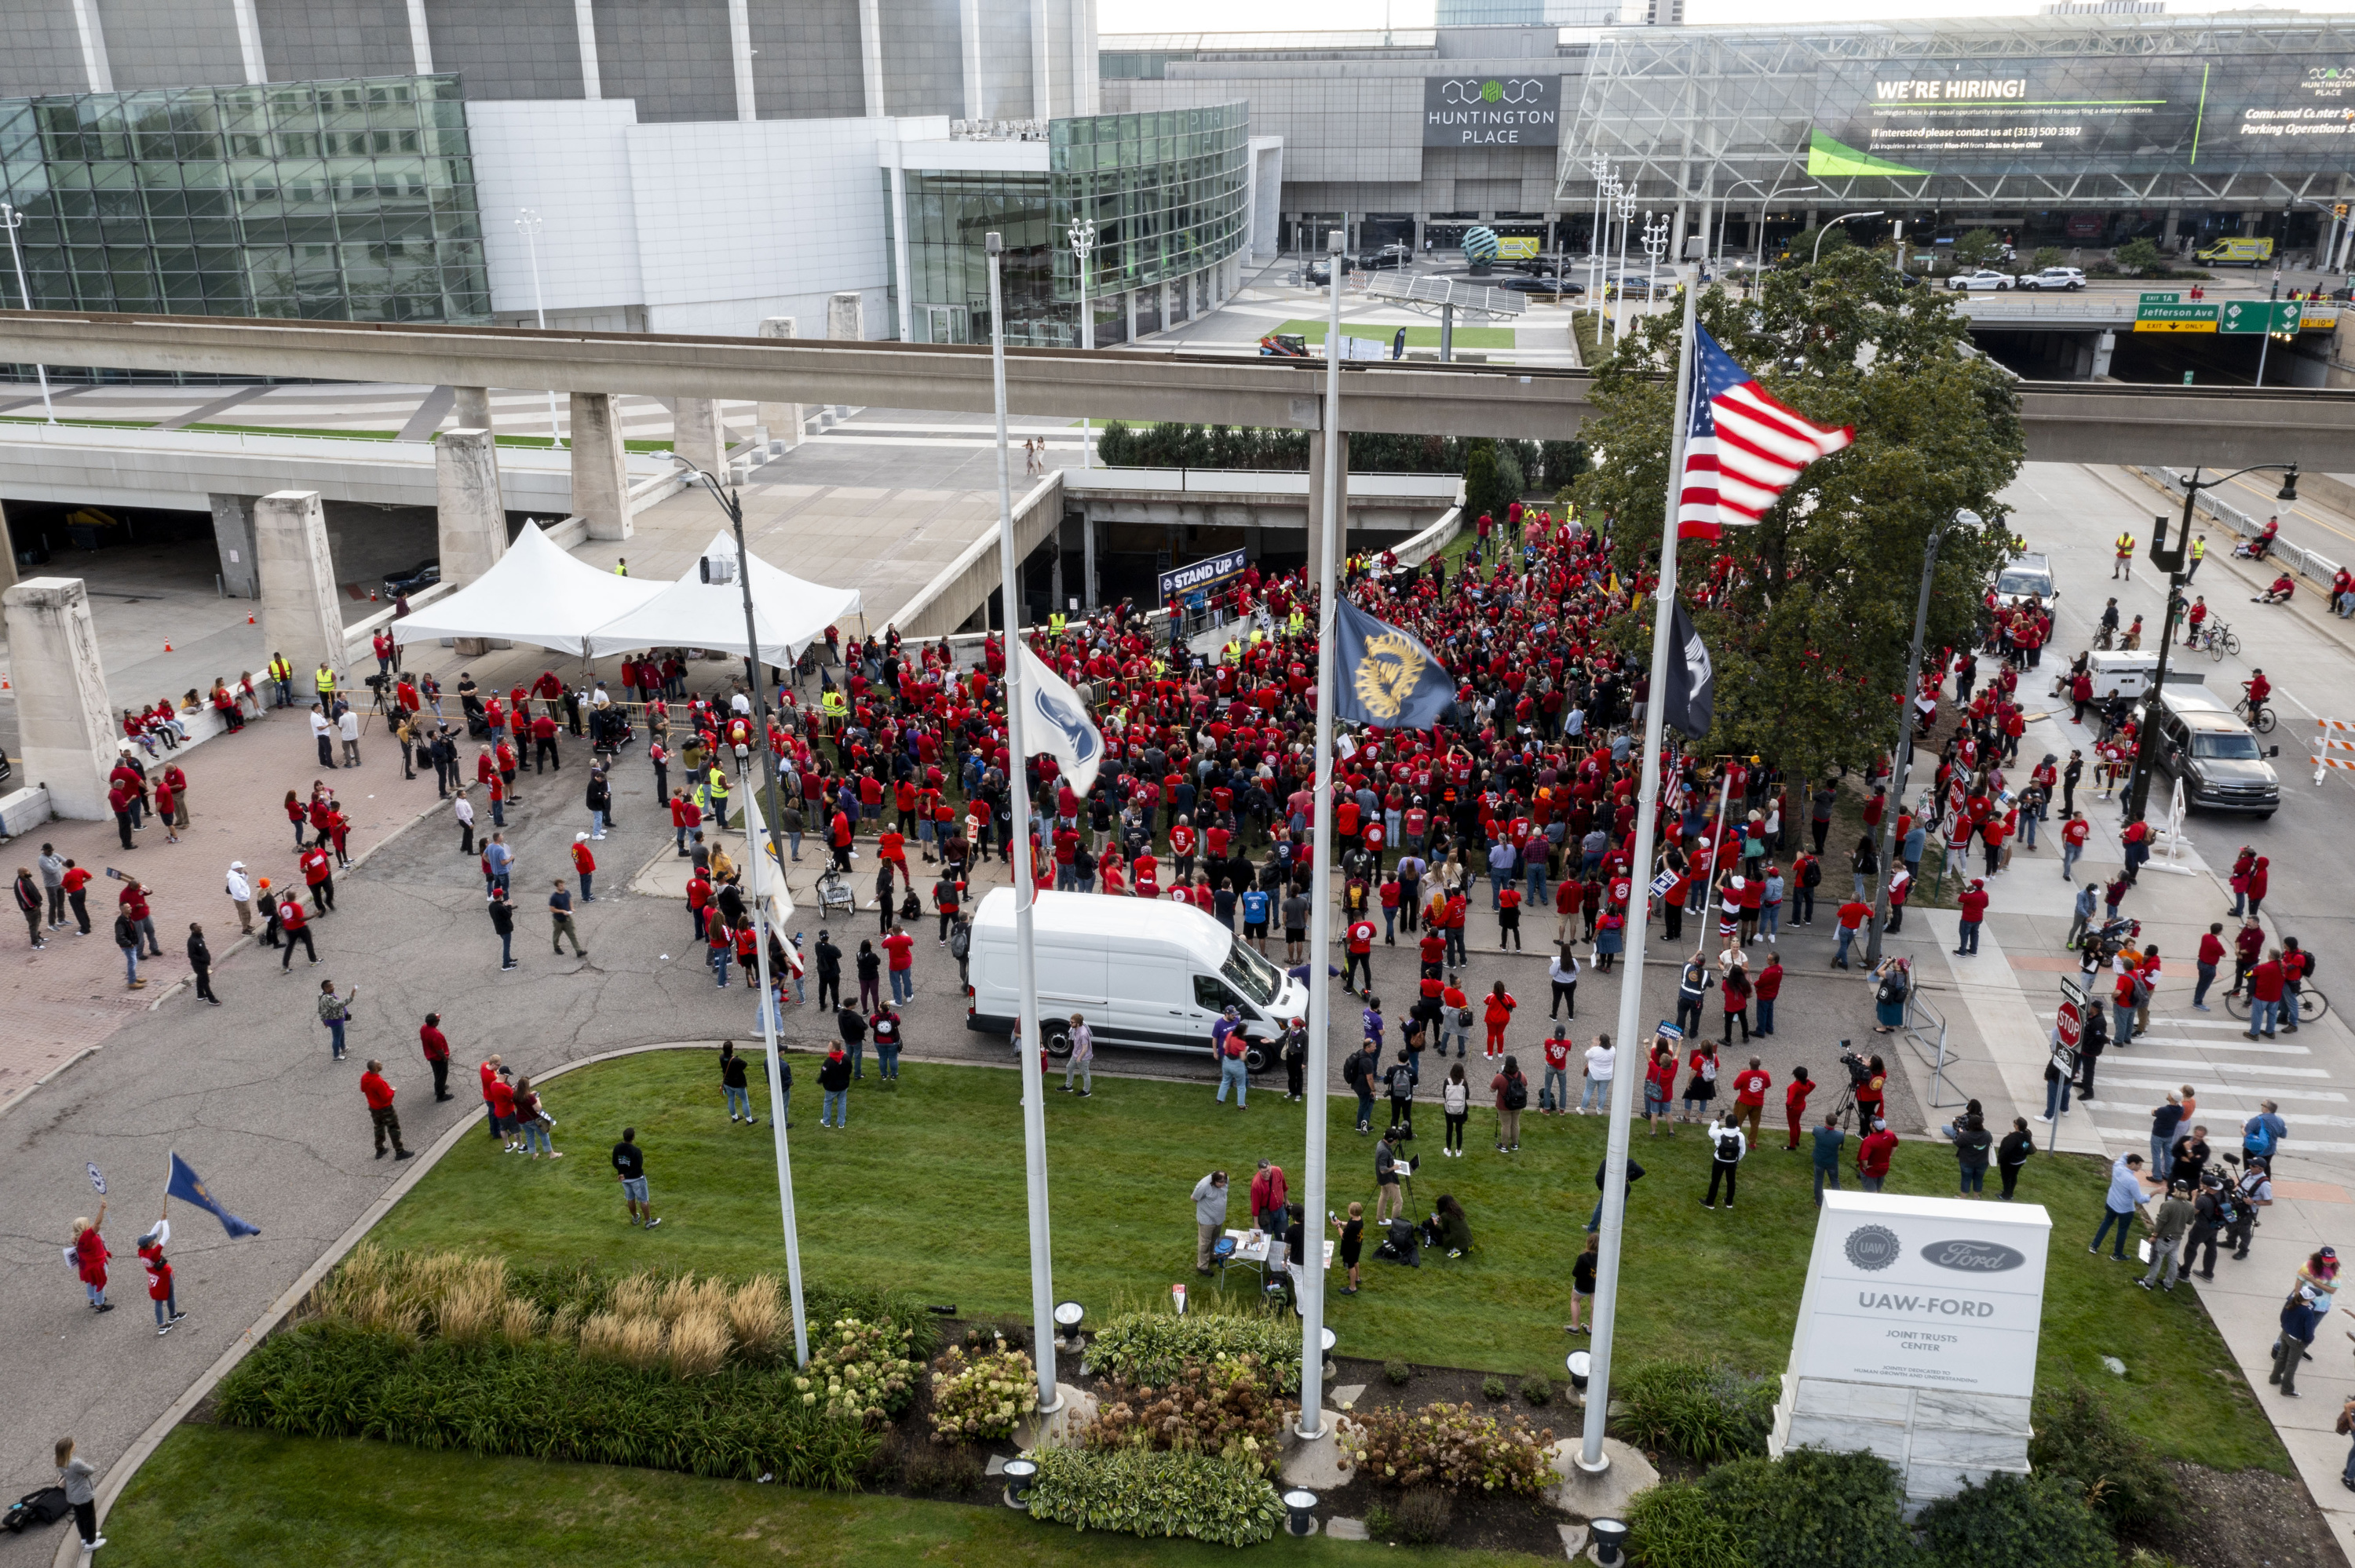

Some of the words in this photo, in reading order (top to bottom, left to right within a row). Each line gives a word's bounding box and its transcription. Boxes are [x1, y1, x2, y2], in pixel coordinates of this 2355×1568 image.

[1876, 80, 1941, 99] WE'RE
[1945, 79, 2026, 98] HIRING!
[1429, 111, 1554, 124] HUNTINGTON
[1871, 129, 1879, 137] If
[1879, 127, 1926, 137] interested
[1926, 127, 1954, 138] please
[1955, 128, 1989, 137] contact
[2003, 128, 2012, 137] at
[2014, 127, 2038, 138] (313)
[2039, 127, 2057, 136] 500
[2057, 127, 2081, 136] 3387
[2241, 123, 2284, 136] Parking
[2285, 122, 2346, 136] Operations
[1462, 130, 1518, 143] PLACE
[1174, 564, 1214, 588] STAND
[1216, 558, 1232, 574] UP
[1950, 784, 1962, 805] STOP
[1663, 870, 1678, 884] UAW
[1650, 882, 1667, 893] STRIKE
[1660, 1025, 1681, 1036] STRONG
[1663, 1021, 1683, 1033] UNITED
[2058, 1010, 2079, 1037] STOP
[2054, 1056, 2062, 1068] BIKE
[2062, 1063, 2072, 1075] LANE
[1860, 1242, 1886, 1255] UAW
[1940, 1242, 2006, 1269] Ford
[1859, 1292, 1994, 1318] UAW-FORD
[1886, 1329, 1918, 1340] JOINT
[1920, 1333, 1958, 1343] TRUSTS
[1900, 1341, 1941, 1351] CENTER
[1924, 1374, 1978, 1384] UNDERSTANDING
